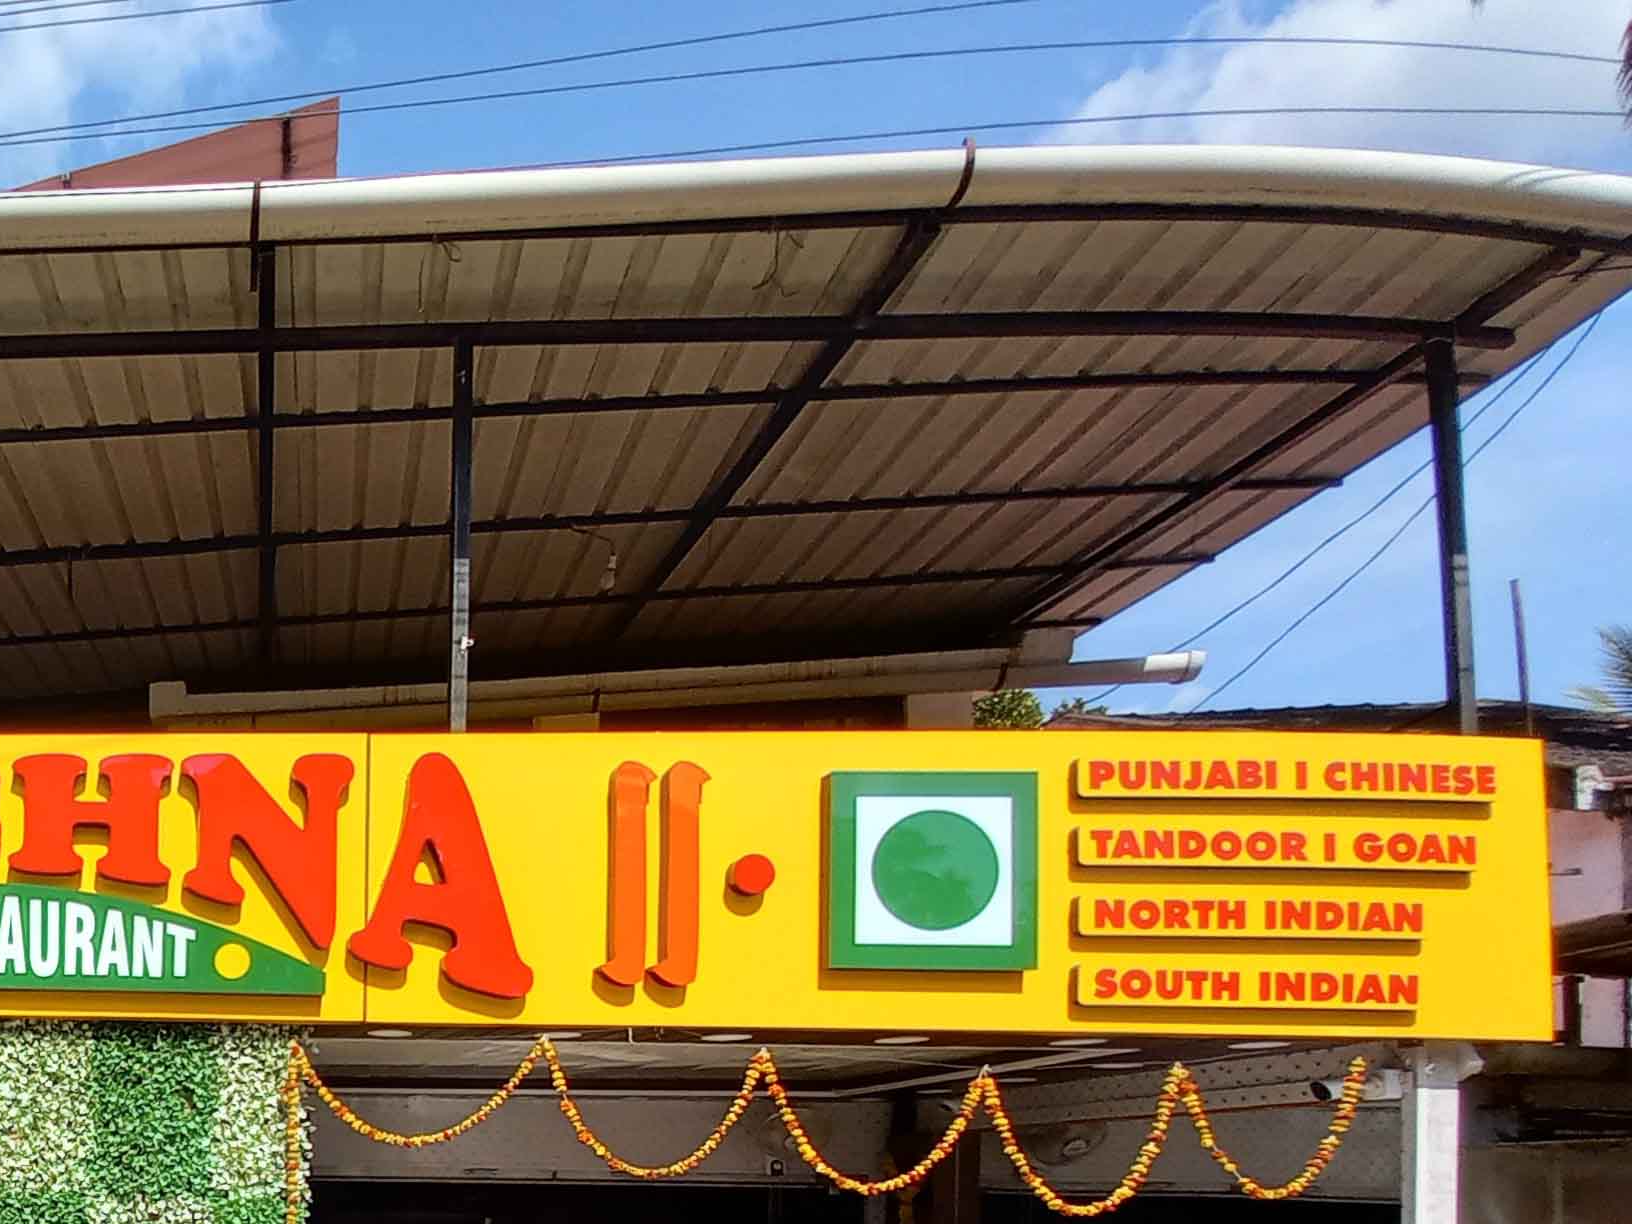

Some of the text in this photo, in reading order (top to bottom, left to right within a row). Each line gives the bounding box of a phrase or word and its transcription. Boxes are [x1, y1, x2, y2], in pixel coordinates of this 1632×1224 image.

[1089, 760, 1277, 790] PUNJABI
[1324, 762, 1496, 795] CHINESE
[1090, 830, 1307, 861] TANDOOR
[1353, 832, 1476, 865] GOAN
[1095, 899, 1423, 933] NORTH INDIAN
[1094, 969, 1418, 1005] SOUTH INDIAN
